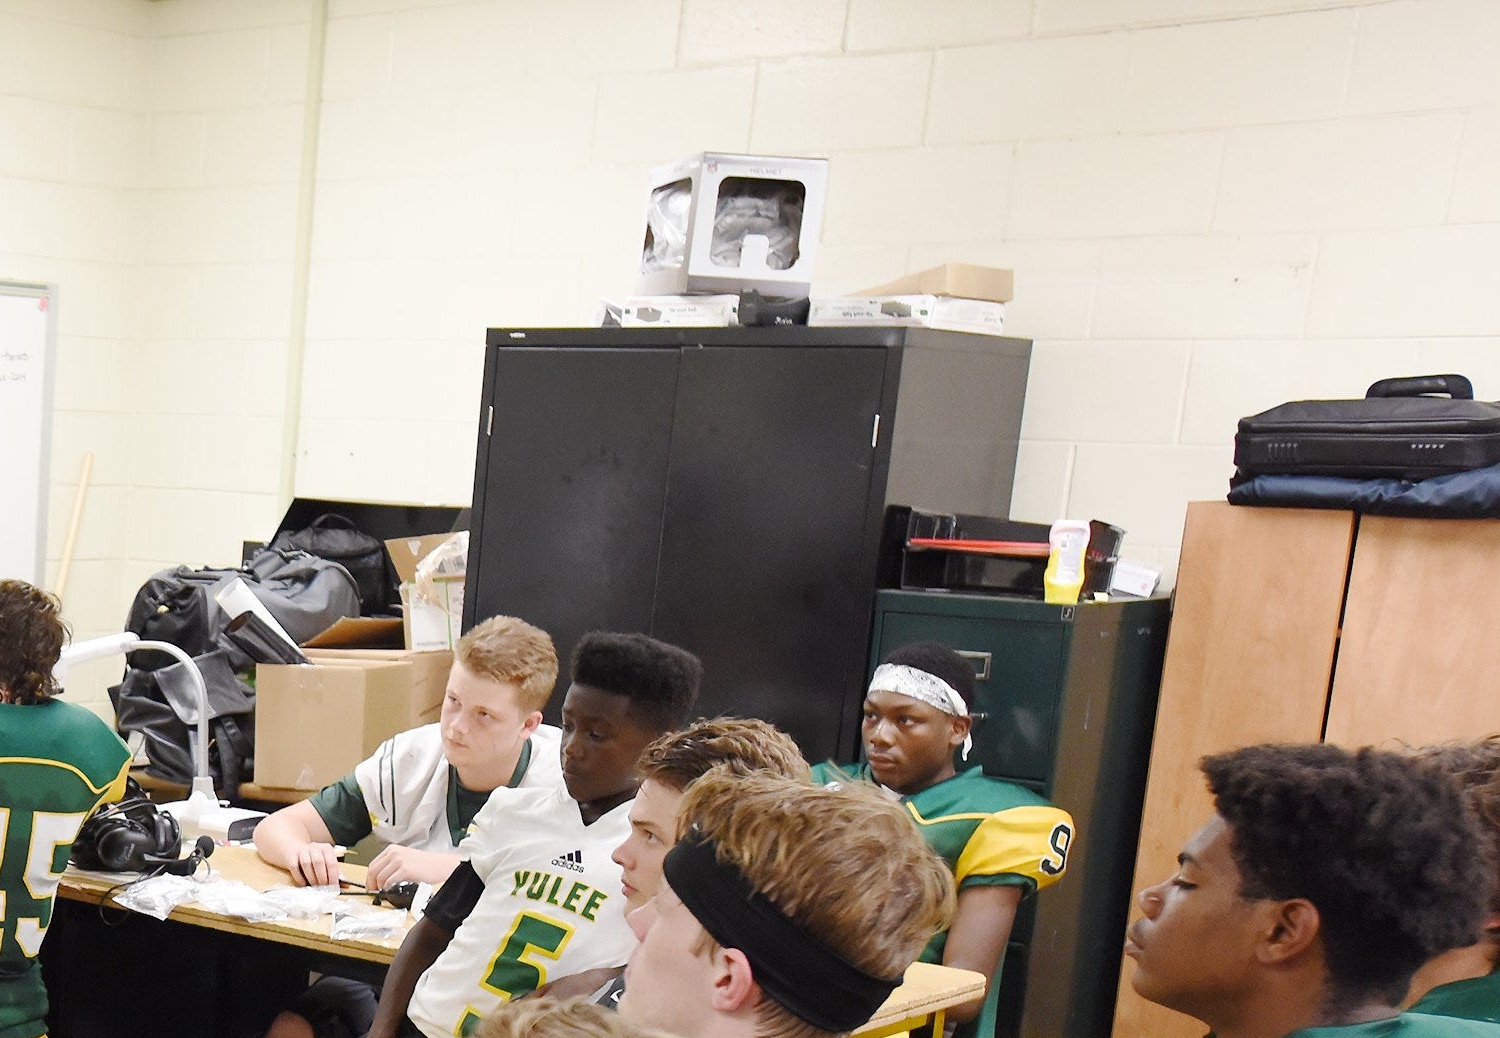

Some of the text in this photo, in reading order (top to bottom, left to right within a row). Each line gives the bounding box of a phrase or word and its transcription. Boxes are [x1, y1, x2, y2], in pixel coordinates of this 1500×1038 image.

[551, 859, 585, 873] adidas
[1039, 822, 1073, 876] 9
[510, 870, 608, 922] YULEE
